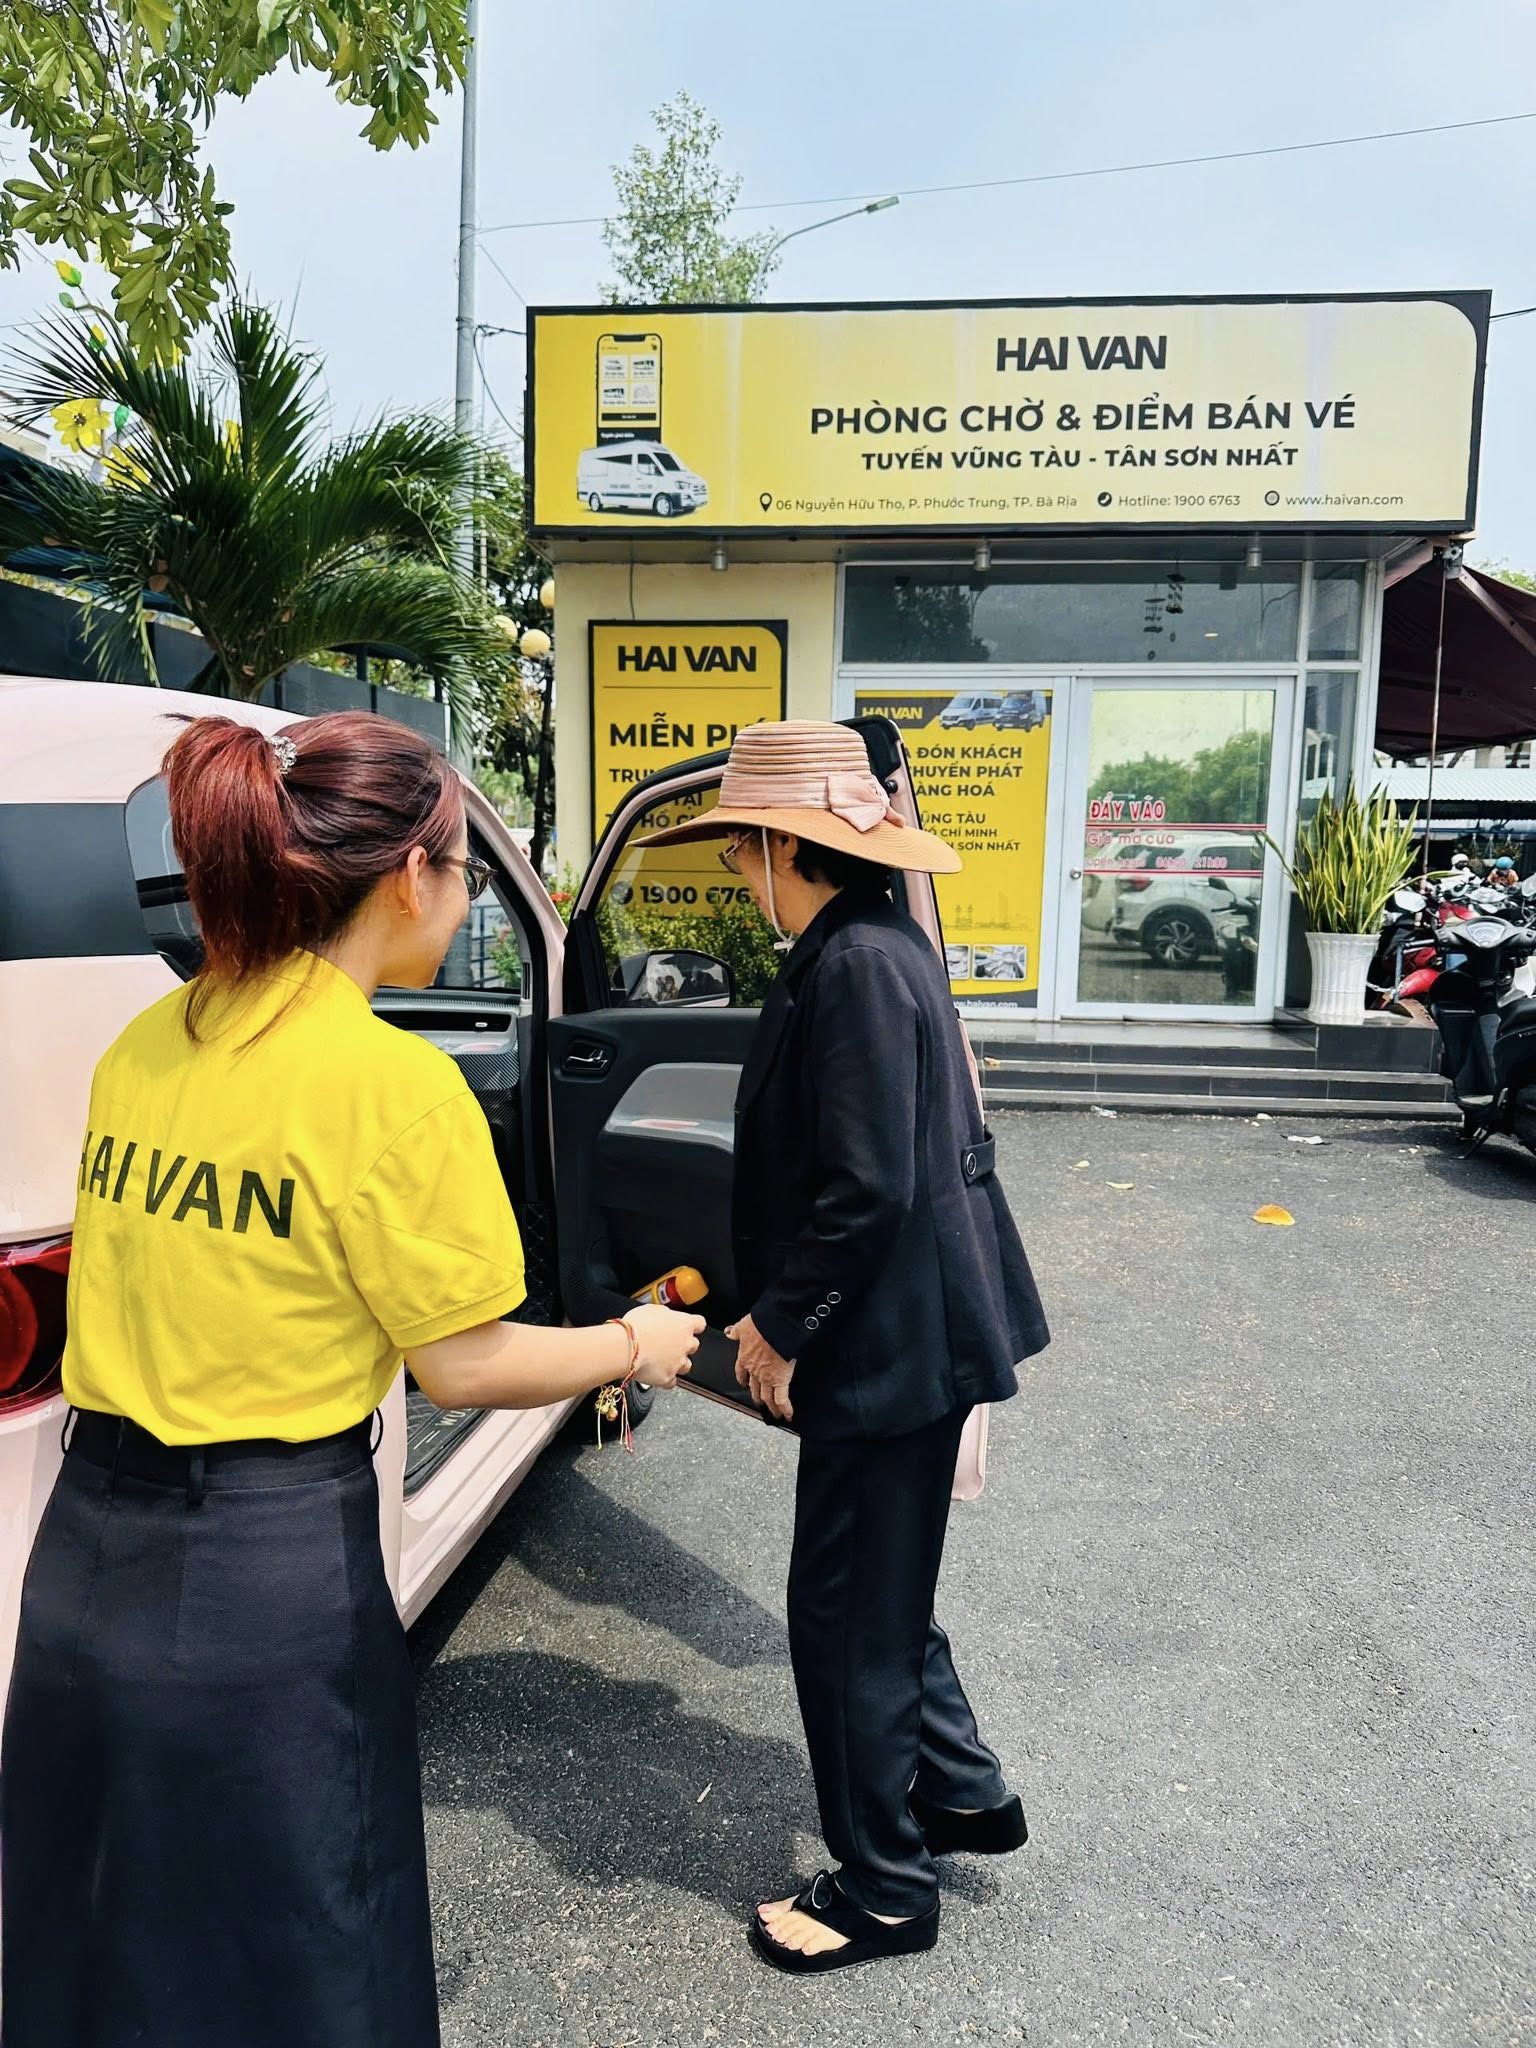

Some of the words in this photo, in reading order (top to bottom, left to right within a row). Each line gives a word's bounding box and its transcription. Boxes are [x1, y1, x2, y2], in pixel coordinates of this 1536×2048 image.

[997, 336, 1069, 371] HAI
[1077, 335, 1167, 370] VAN
[811, 400, 947, 434] PHÒNG
[960, 397, 1044, 432] CHỜ
[1056, 404, 1081, 430] &
[1093, 392, 1193, 430] ĐIỂM
[1208, 395, 1290, 430] BÁN
[1304, 393, 1355, 428] VÉ
[861, 445, 943, 470] TUYẾN
[950, 446, 1022, 469] VŨNG
[1030, 445, 1081, 468] TÀU
[1105, 444, 1156, 467] TÂN
[1164, 446, 1217, 466] SƠN
[1226, 441, 1298, 466] NHẤT
[776, 499, 792, 510] 06
[796, 498, 845, 512] Nguyễn
[849, 499, 875, 510] Hữu
[909, 498, 921, 509] P.
[924, 497, 965, 508] Phước
[968, 497, 1009, 510] Trung,
[1013, 497, 1032, 507] TP.
[1036, 496, 1053, 507] Bà
[1057, 496, 1078, 508] Rịa
[1118, 495, 1171, 506] Hotline:
[1174, 495, 1205, 506] 1900
[1208, 495, 1240, 506] 6763
[1286, 493, 1404, 506] www.haivan.com
[618, 645, 676, 672] HAI
[683, 645, 757, 672] VAN
[891, 707, 923, 719] VAN
[610, 712, 694, 747] MIỄN
[917, 744, 955, 758] ĐÓN
[961, 744, 1022, 758] KHÁCH
[910, 761, 971, 777] HUYỂN
[977, 762, 1023, 777] PHÁT
[916, 781, 952, 796] ÀNG
[957, 781, 995, 796] HOÁ
[1089, 791, 1124, 820] ĐẨY
[921, 810, 952, 824] ŨNG
[957, 811, 986, 824] TÀU
[965, 829, 997, 837] MINH
[957, 841, 983, 851] SƠN
[987, 839, 1021, 851] NHẤT
[640, 886, 697, 904] 1900
[706, 887, 751, 904] 676
[145, 1148, 295, 1238] VAN
